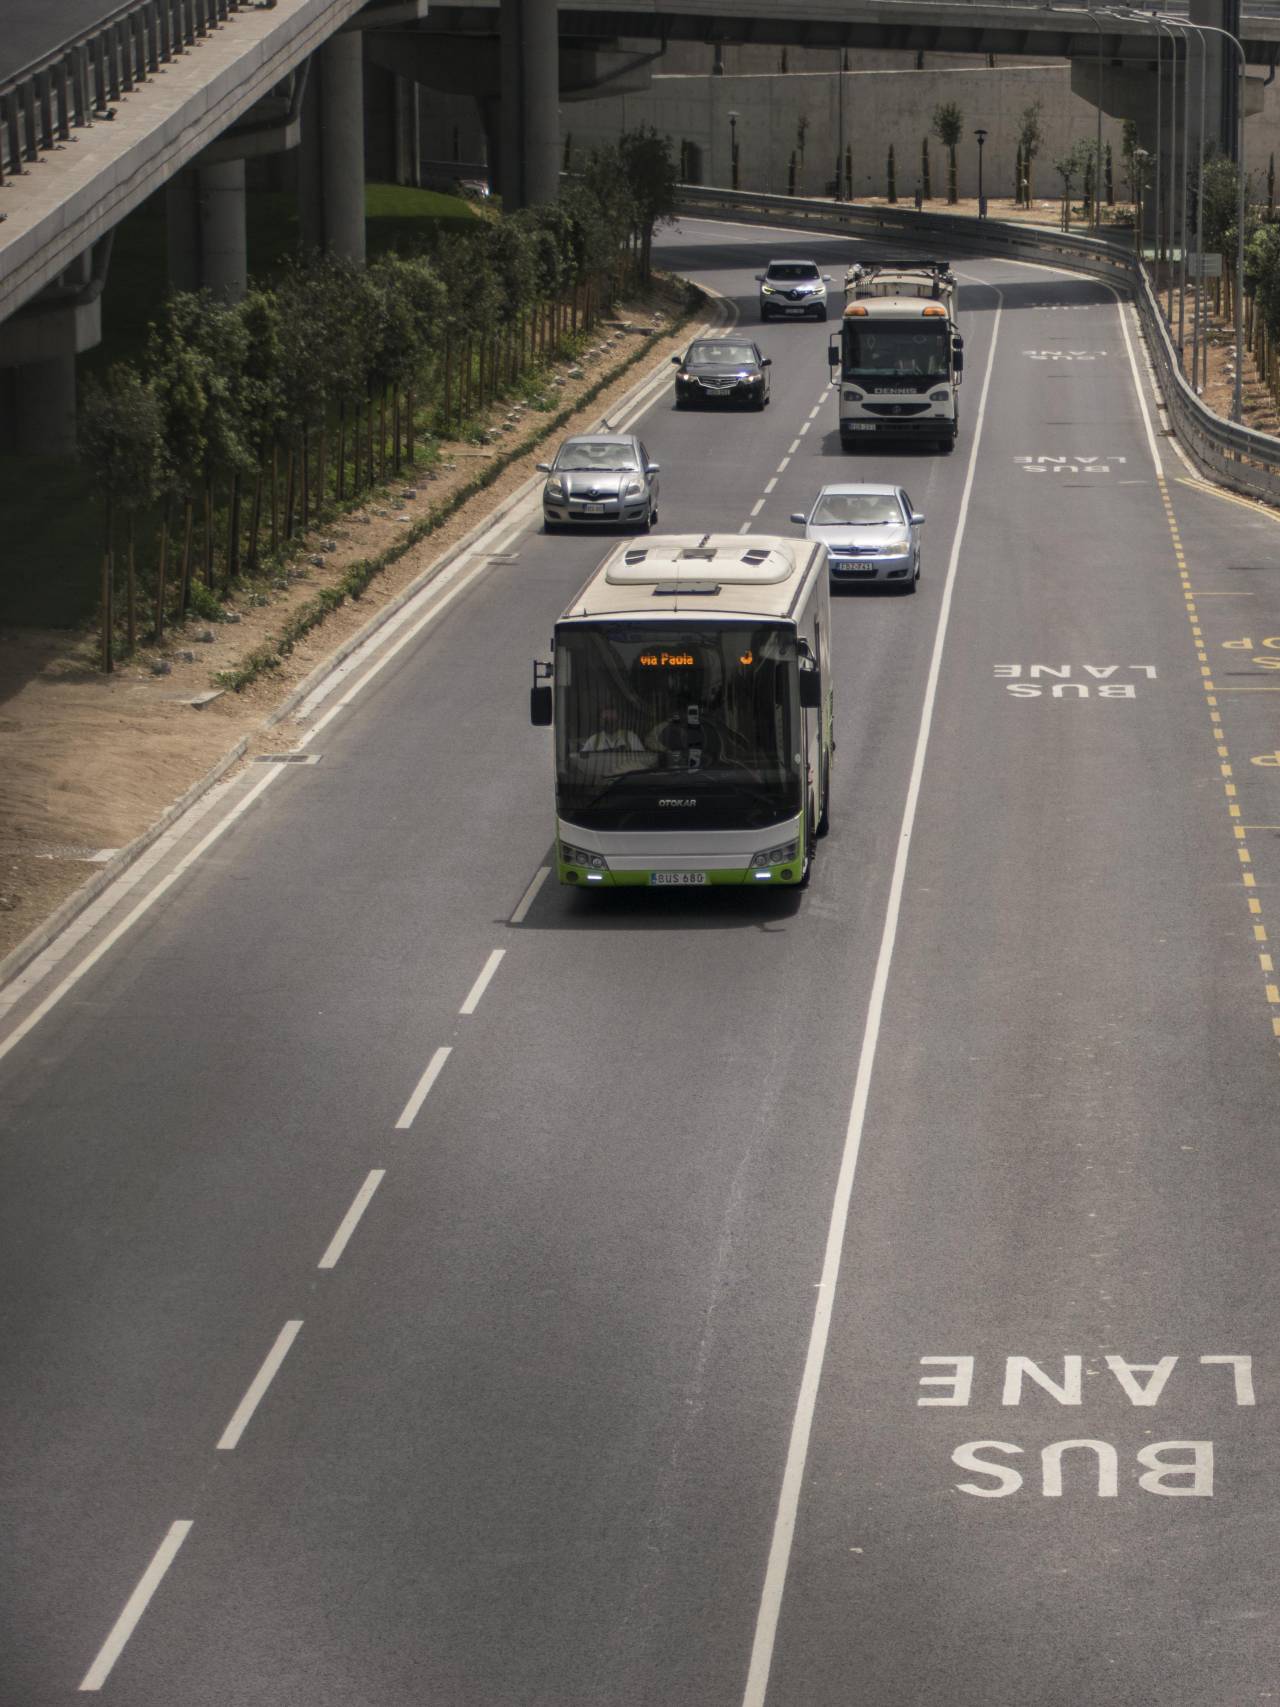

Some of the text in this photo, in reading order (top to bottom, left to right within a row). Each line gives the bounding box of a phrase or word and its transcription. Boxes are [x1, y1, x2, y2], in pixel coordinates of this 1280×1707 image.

[1013, 455, 1127, 464] LANE
[1022, 465, 1110, 473] BUS
[993, 664, 1158, 679] LANE
[1006, 683, 1137, 699] BUS
[658, 799, 697, 808] OTOKAR
[657, 873, 680, 883] BUS
[917, 1355, 1256, 1406] LANE
[950, 1439, 1213, 1498] BUS
